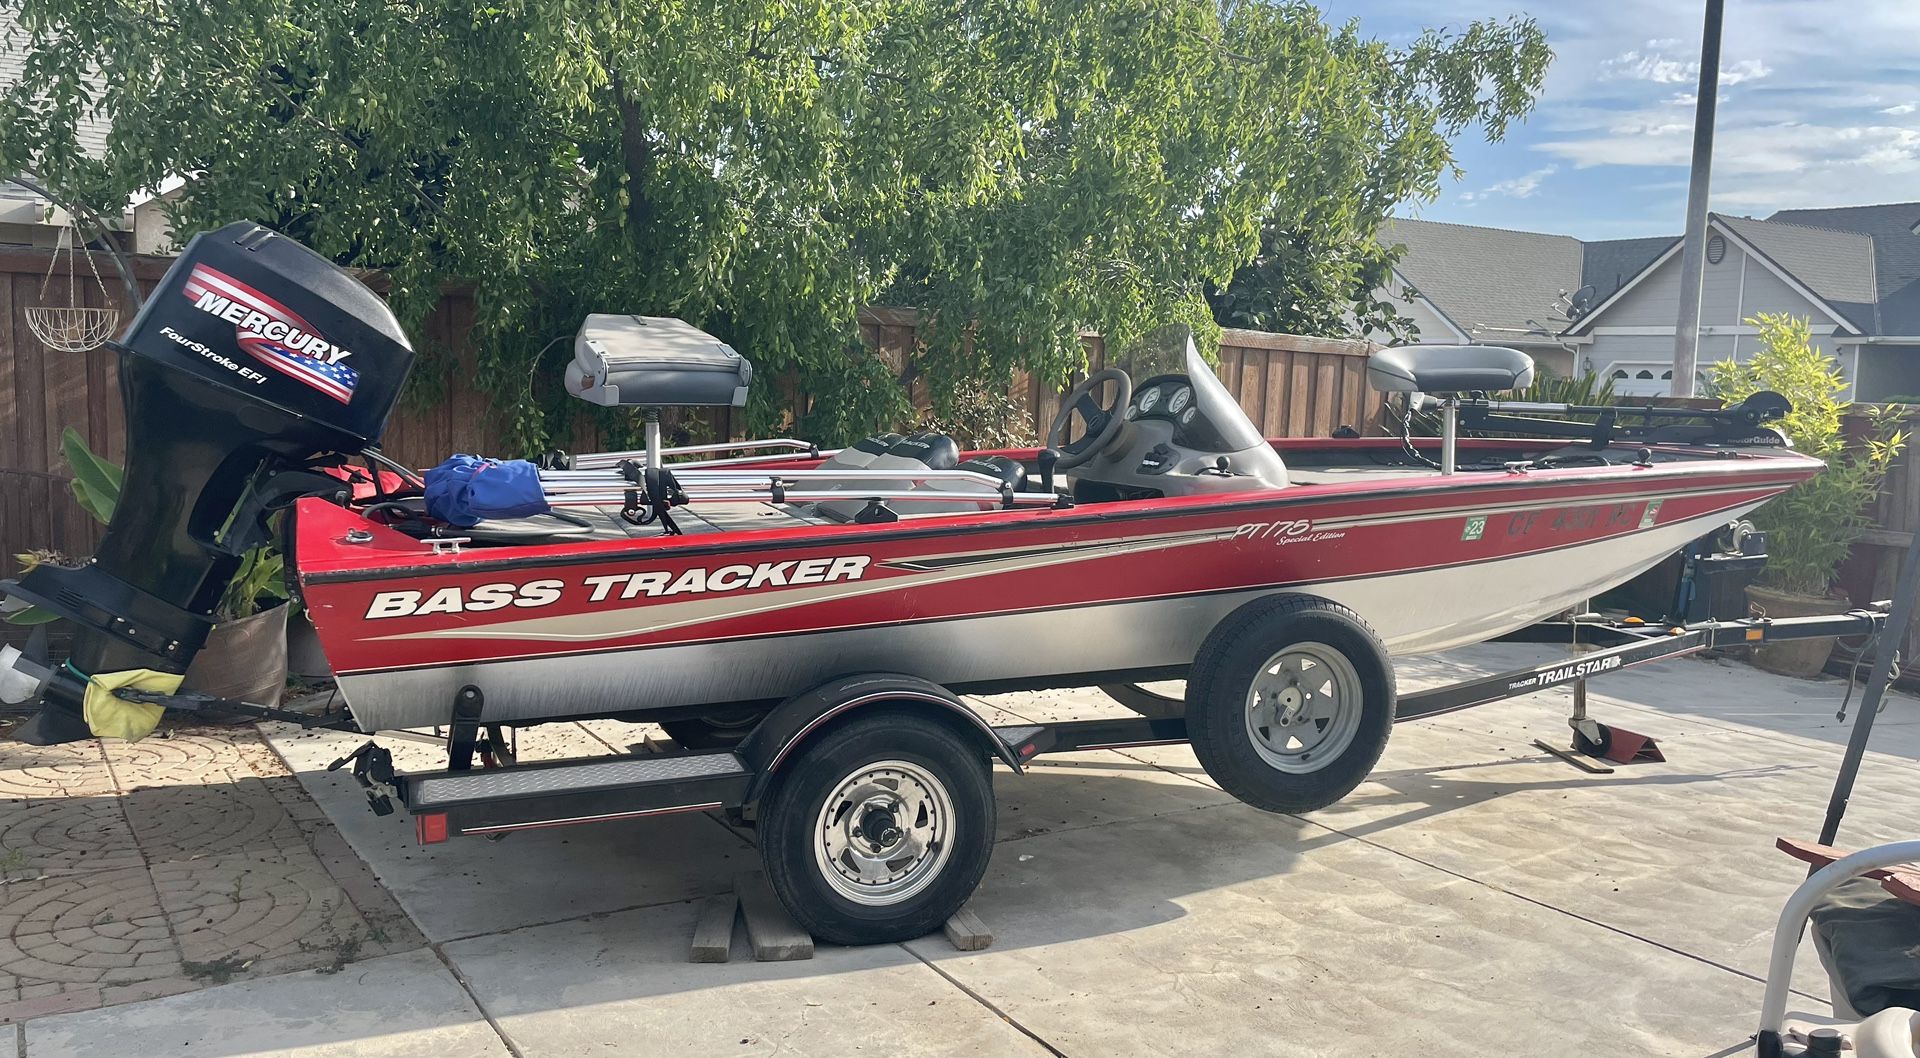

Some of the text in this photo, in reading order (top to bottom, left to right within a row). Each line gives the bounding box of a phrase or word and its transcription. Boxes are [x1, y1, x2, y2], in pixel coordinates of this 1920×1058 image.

[194, 290, 352, 366] MERCURY
[159, 326, 268, 385] FourStroke EFI
[1276, 531, 1346, 546] Special Edition
[1468, 520, 1486, 536] 23
[364, 554, 873, 621] BASS TRACKER
[1508, 656, 1611, 690] TRACKER TRAILSTAR
